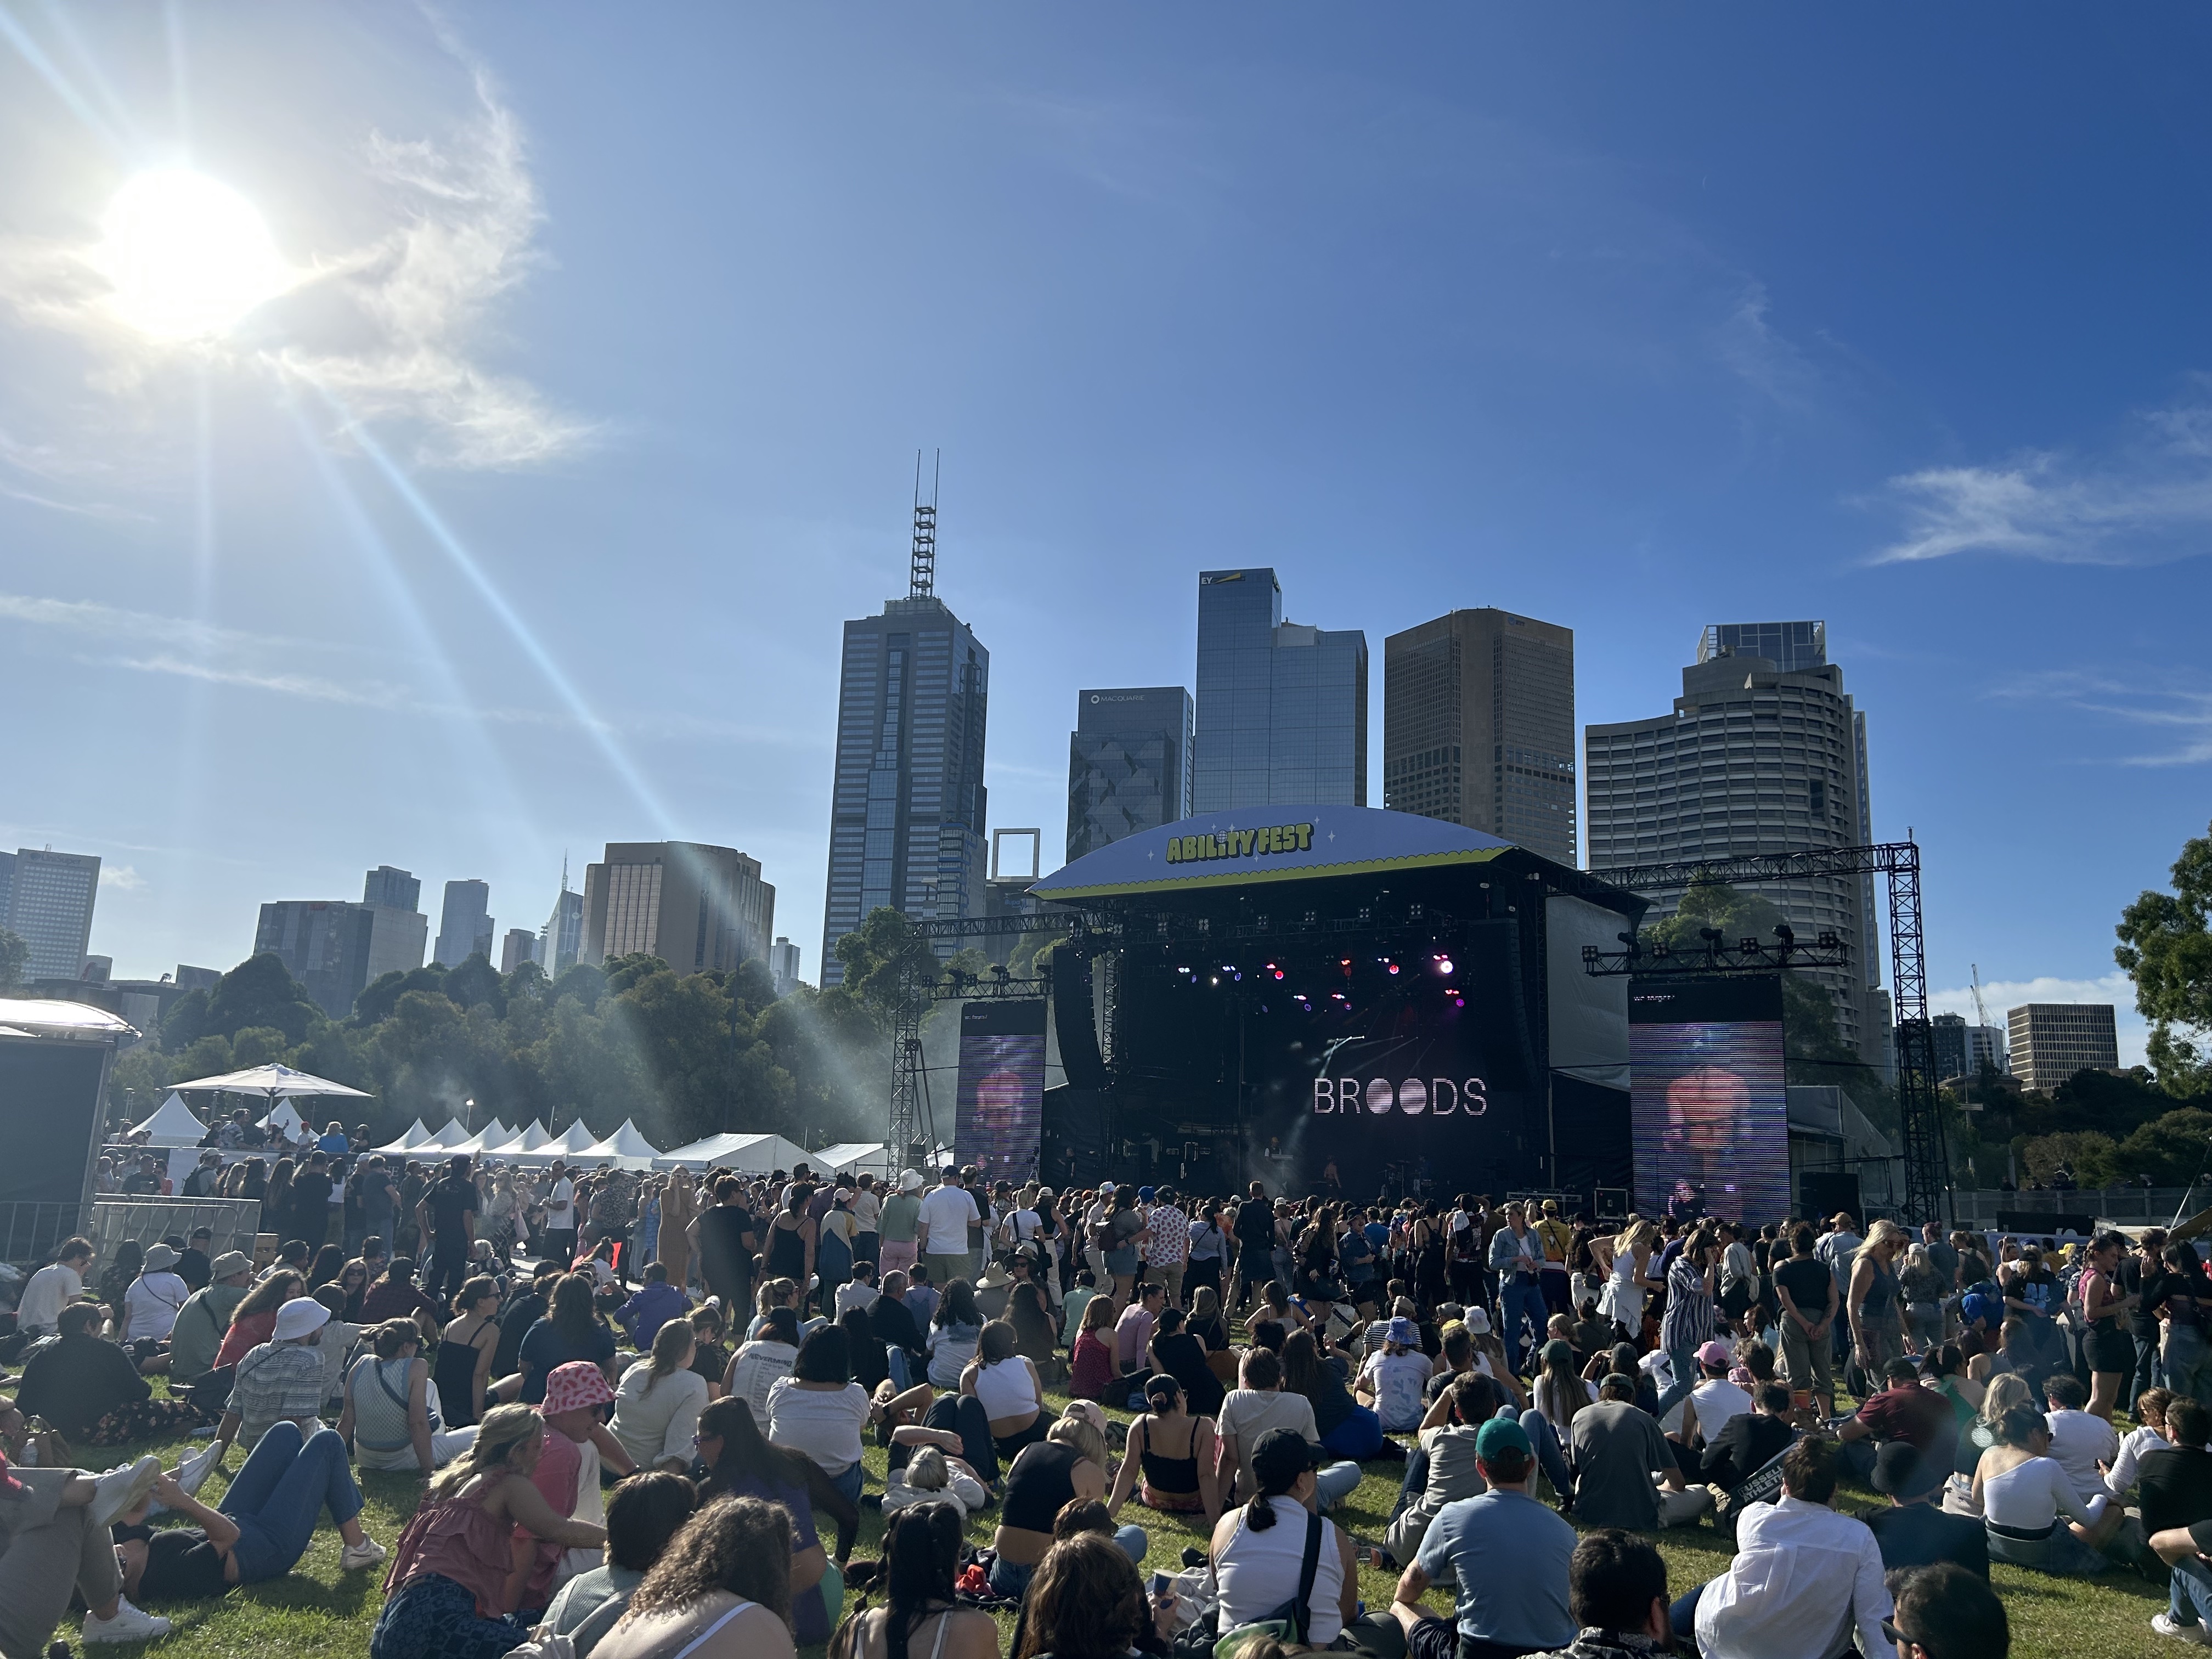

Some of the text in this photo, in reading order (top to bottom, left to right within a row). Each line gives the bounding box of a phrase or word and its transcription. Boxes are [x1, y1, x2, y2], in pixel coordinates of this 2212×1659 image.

[1201, 577, 1213, 585] EY
[1166, 823, 1314, 864] ABILITY FEST
[1314, 1077, 1488, 1116] BROODS
[748, 1353, 793, 1367] NEVERMIND
[1737, 1465, 1784, 1497] RUSSELL
